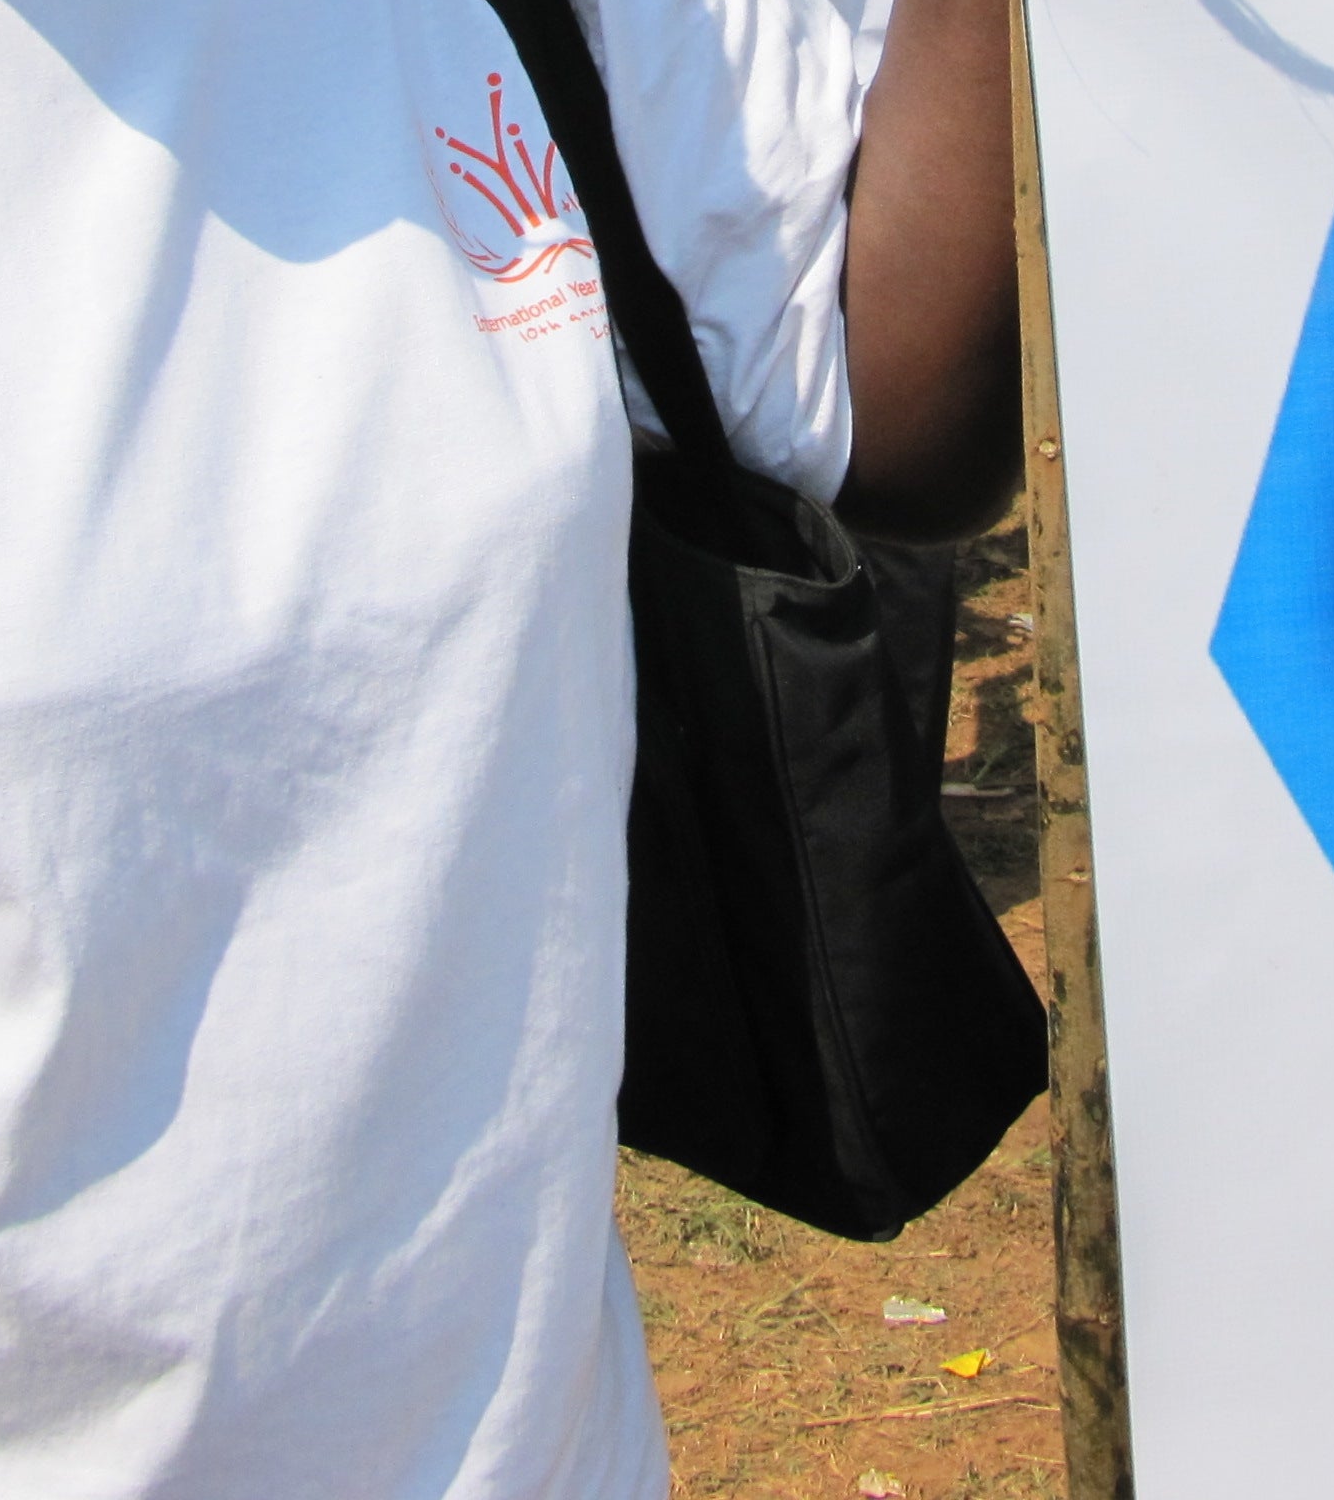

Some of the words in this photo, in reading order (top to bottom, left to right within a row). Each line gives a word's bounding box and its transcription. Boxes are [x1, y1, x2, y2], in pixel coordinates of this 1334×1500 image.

[473, 287, 568, 333] International
[566, 279, 599, 298] Year
[518, 319, 562, 343] 10th
